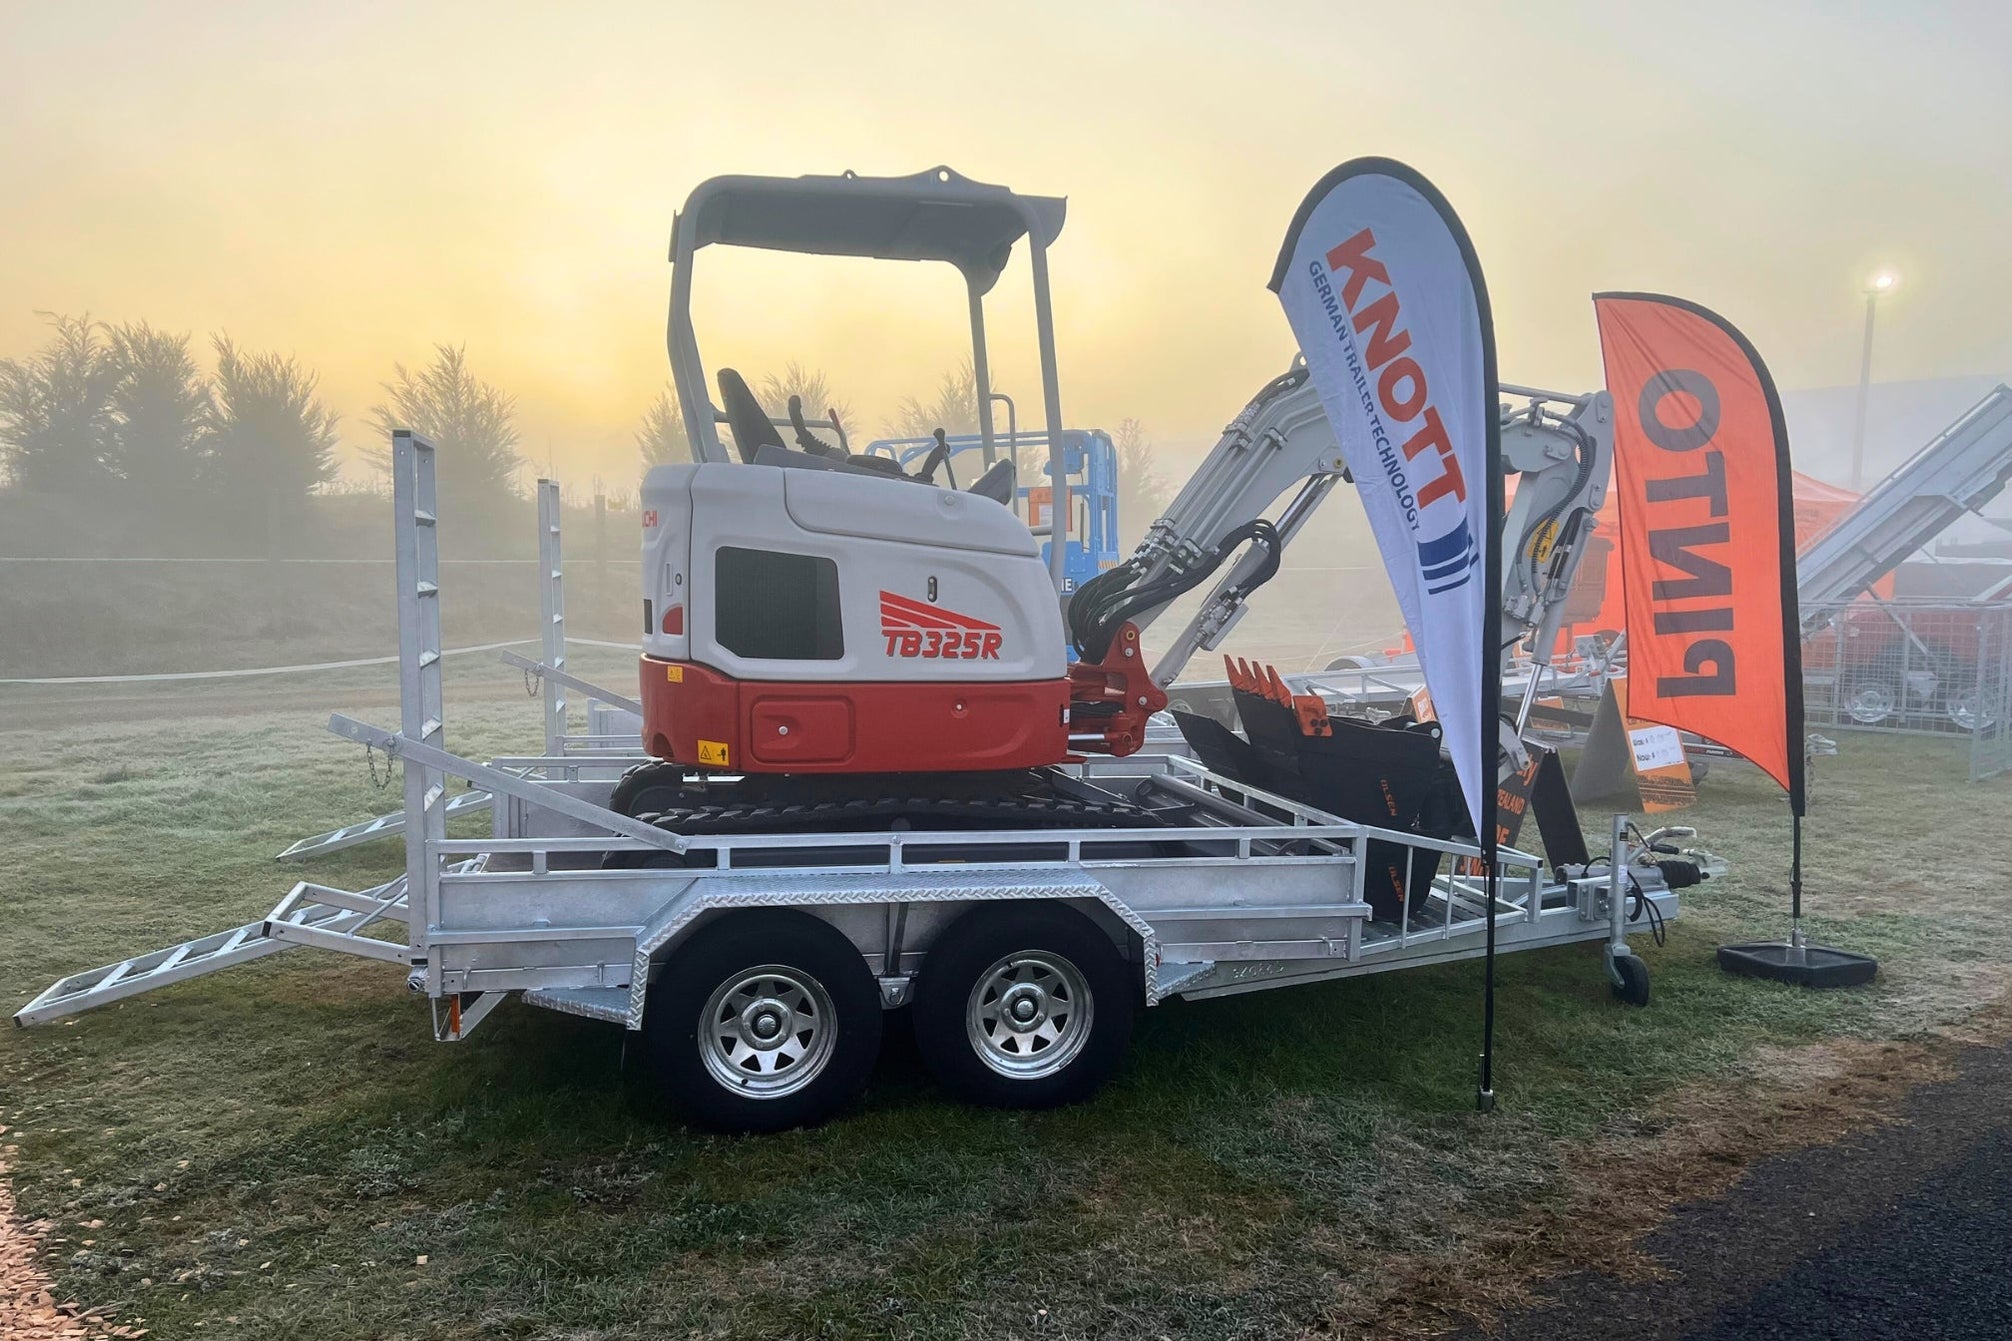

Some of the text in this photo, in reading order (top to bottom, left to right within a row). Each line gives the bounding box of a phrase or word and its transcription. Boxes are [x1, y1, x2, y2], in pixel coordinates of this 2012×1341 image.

[1308, 259, 1422, 531] GERMAN TRAILER TECHNOLOGY
[1325, 226, 1467, 511] KNOTT
[881, 629, 1003, 660] TB325R
